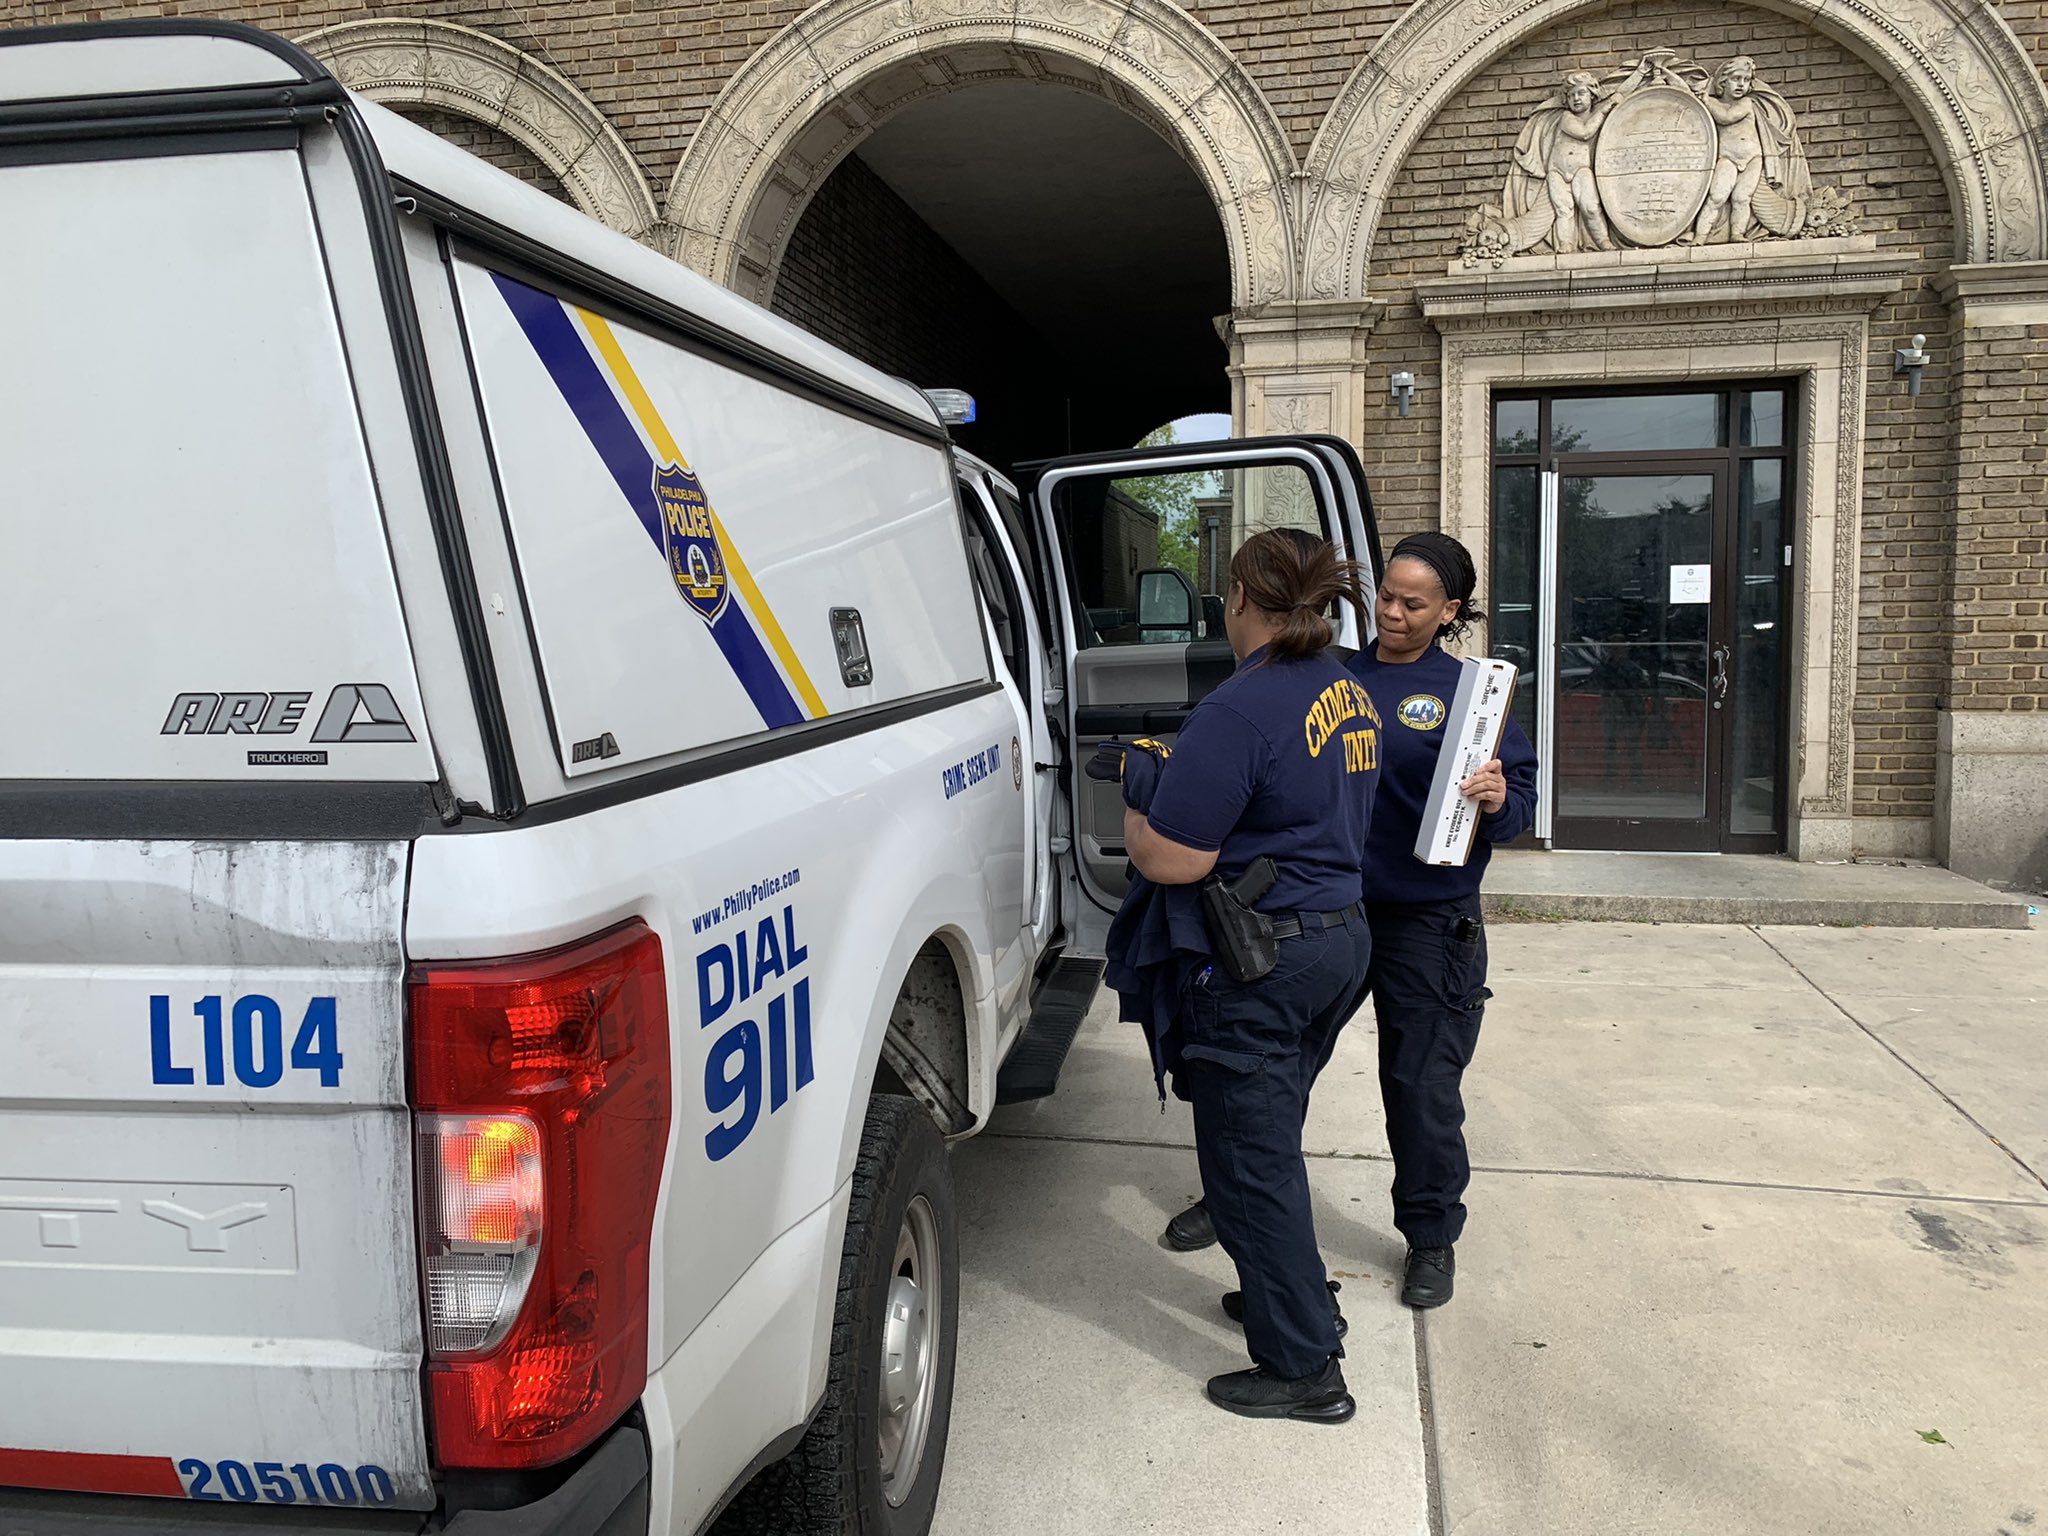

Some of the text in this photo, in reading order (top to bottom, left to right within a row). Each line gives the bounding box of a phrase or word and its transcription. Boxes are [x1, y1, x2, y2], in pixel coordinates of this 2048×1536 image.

[660, 485, 703, 502] PHILADELPHIA
[664, 502, 711, 538] POLICE
[160, 691, 313, 735] ARE
[1305, 679, 1357, 758] CRIME
[250, 753, 319, 763] TRUCK HERO
[942, 762, 967, 800] CRIME
[966, 751, 987, 786] SCENE
[987, 743, 1001, 773] UNIT
[1342, 730, 1377, 774] UNIT
[692, 868, 800, 935] www.PhillyPolice.com
[696, 904, 808, 1029] DIAL
[149, 994, 343, 1088] L104
[704, 975, 815, 1162] 911
[178, 1458, 398, 1506] 205100
